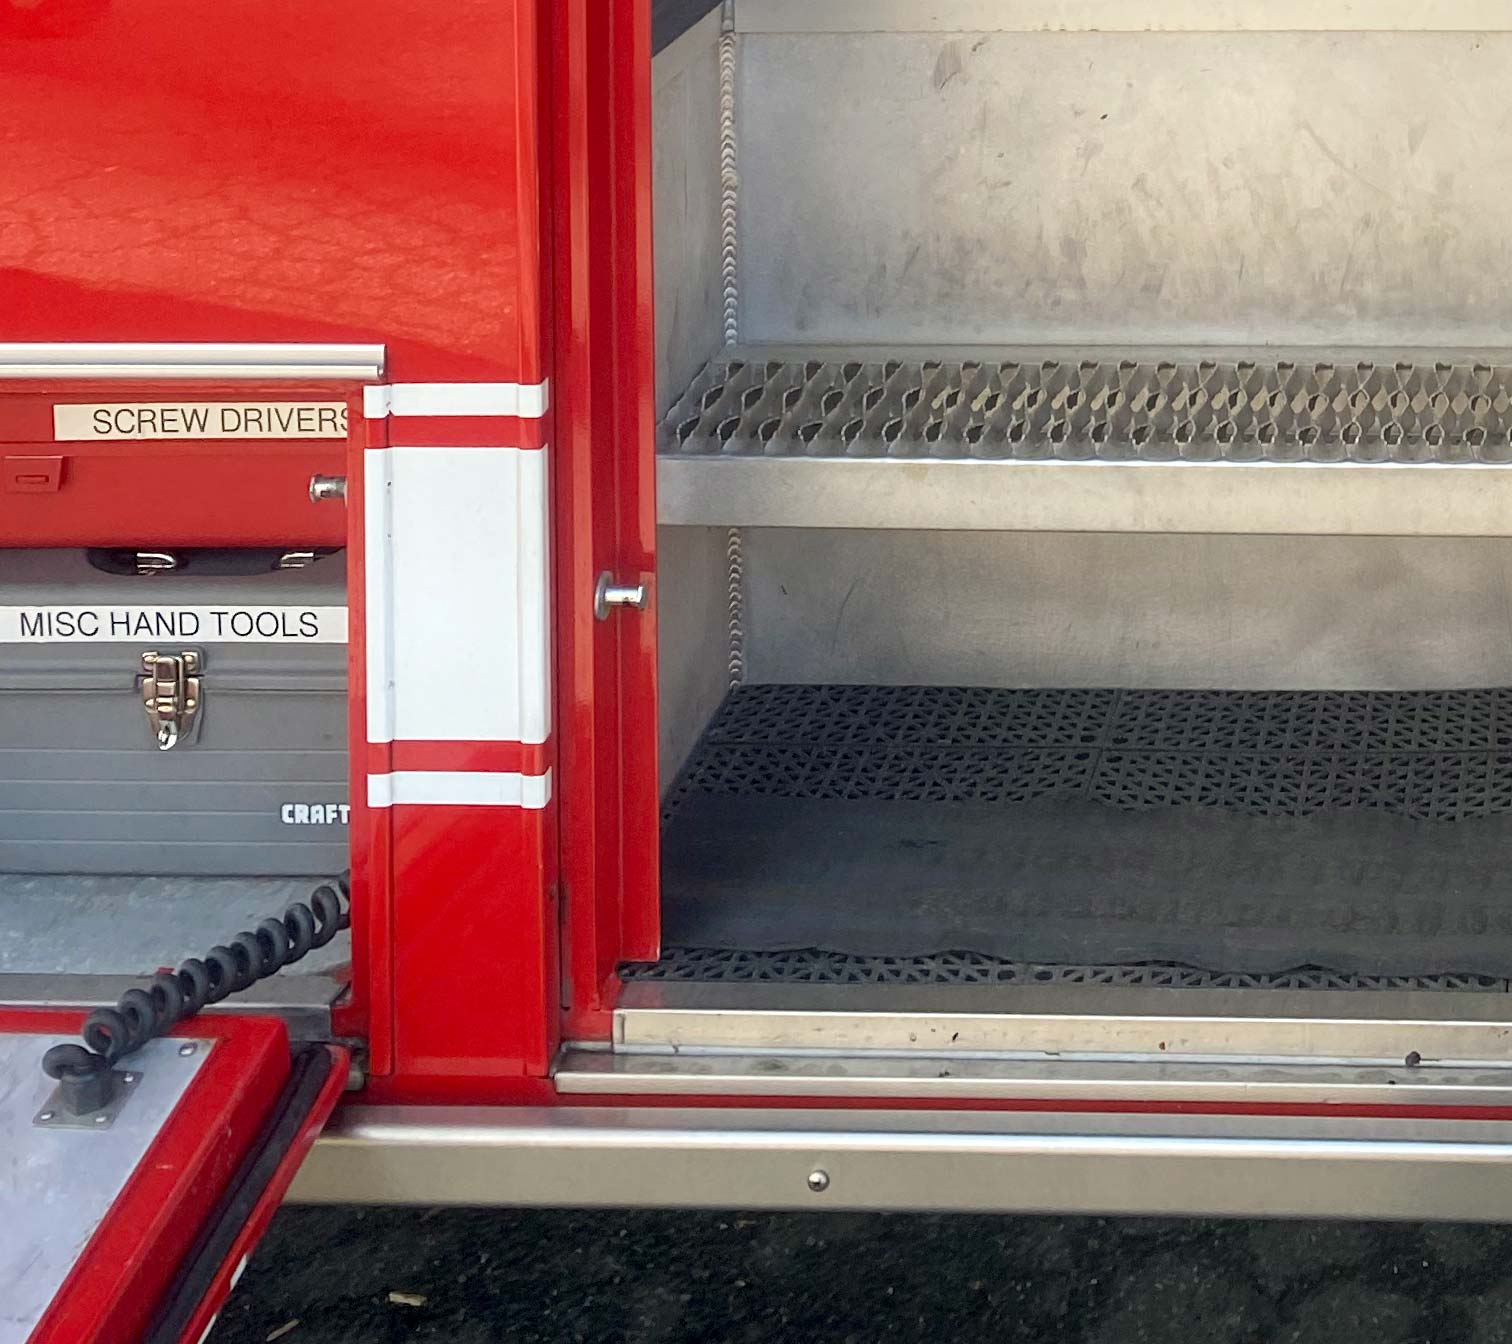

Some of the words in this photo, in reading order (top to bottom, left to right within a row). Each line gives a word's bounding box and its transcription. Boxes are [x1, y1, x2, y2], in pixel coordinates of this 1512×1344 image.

[93, 407, 209, 434] SCREW
[20, 611, 99, 637] MISC
[110, 611, 199, 637] HAND
[210, 611, 319, 637] TOOLS
[281, 803, 351, 824] CRAFT
